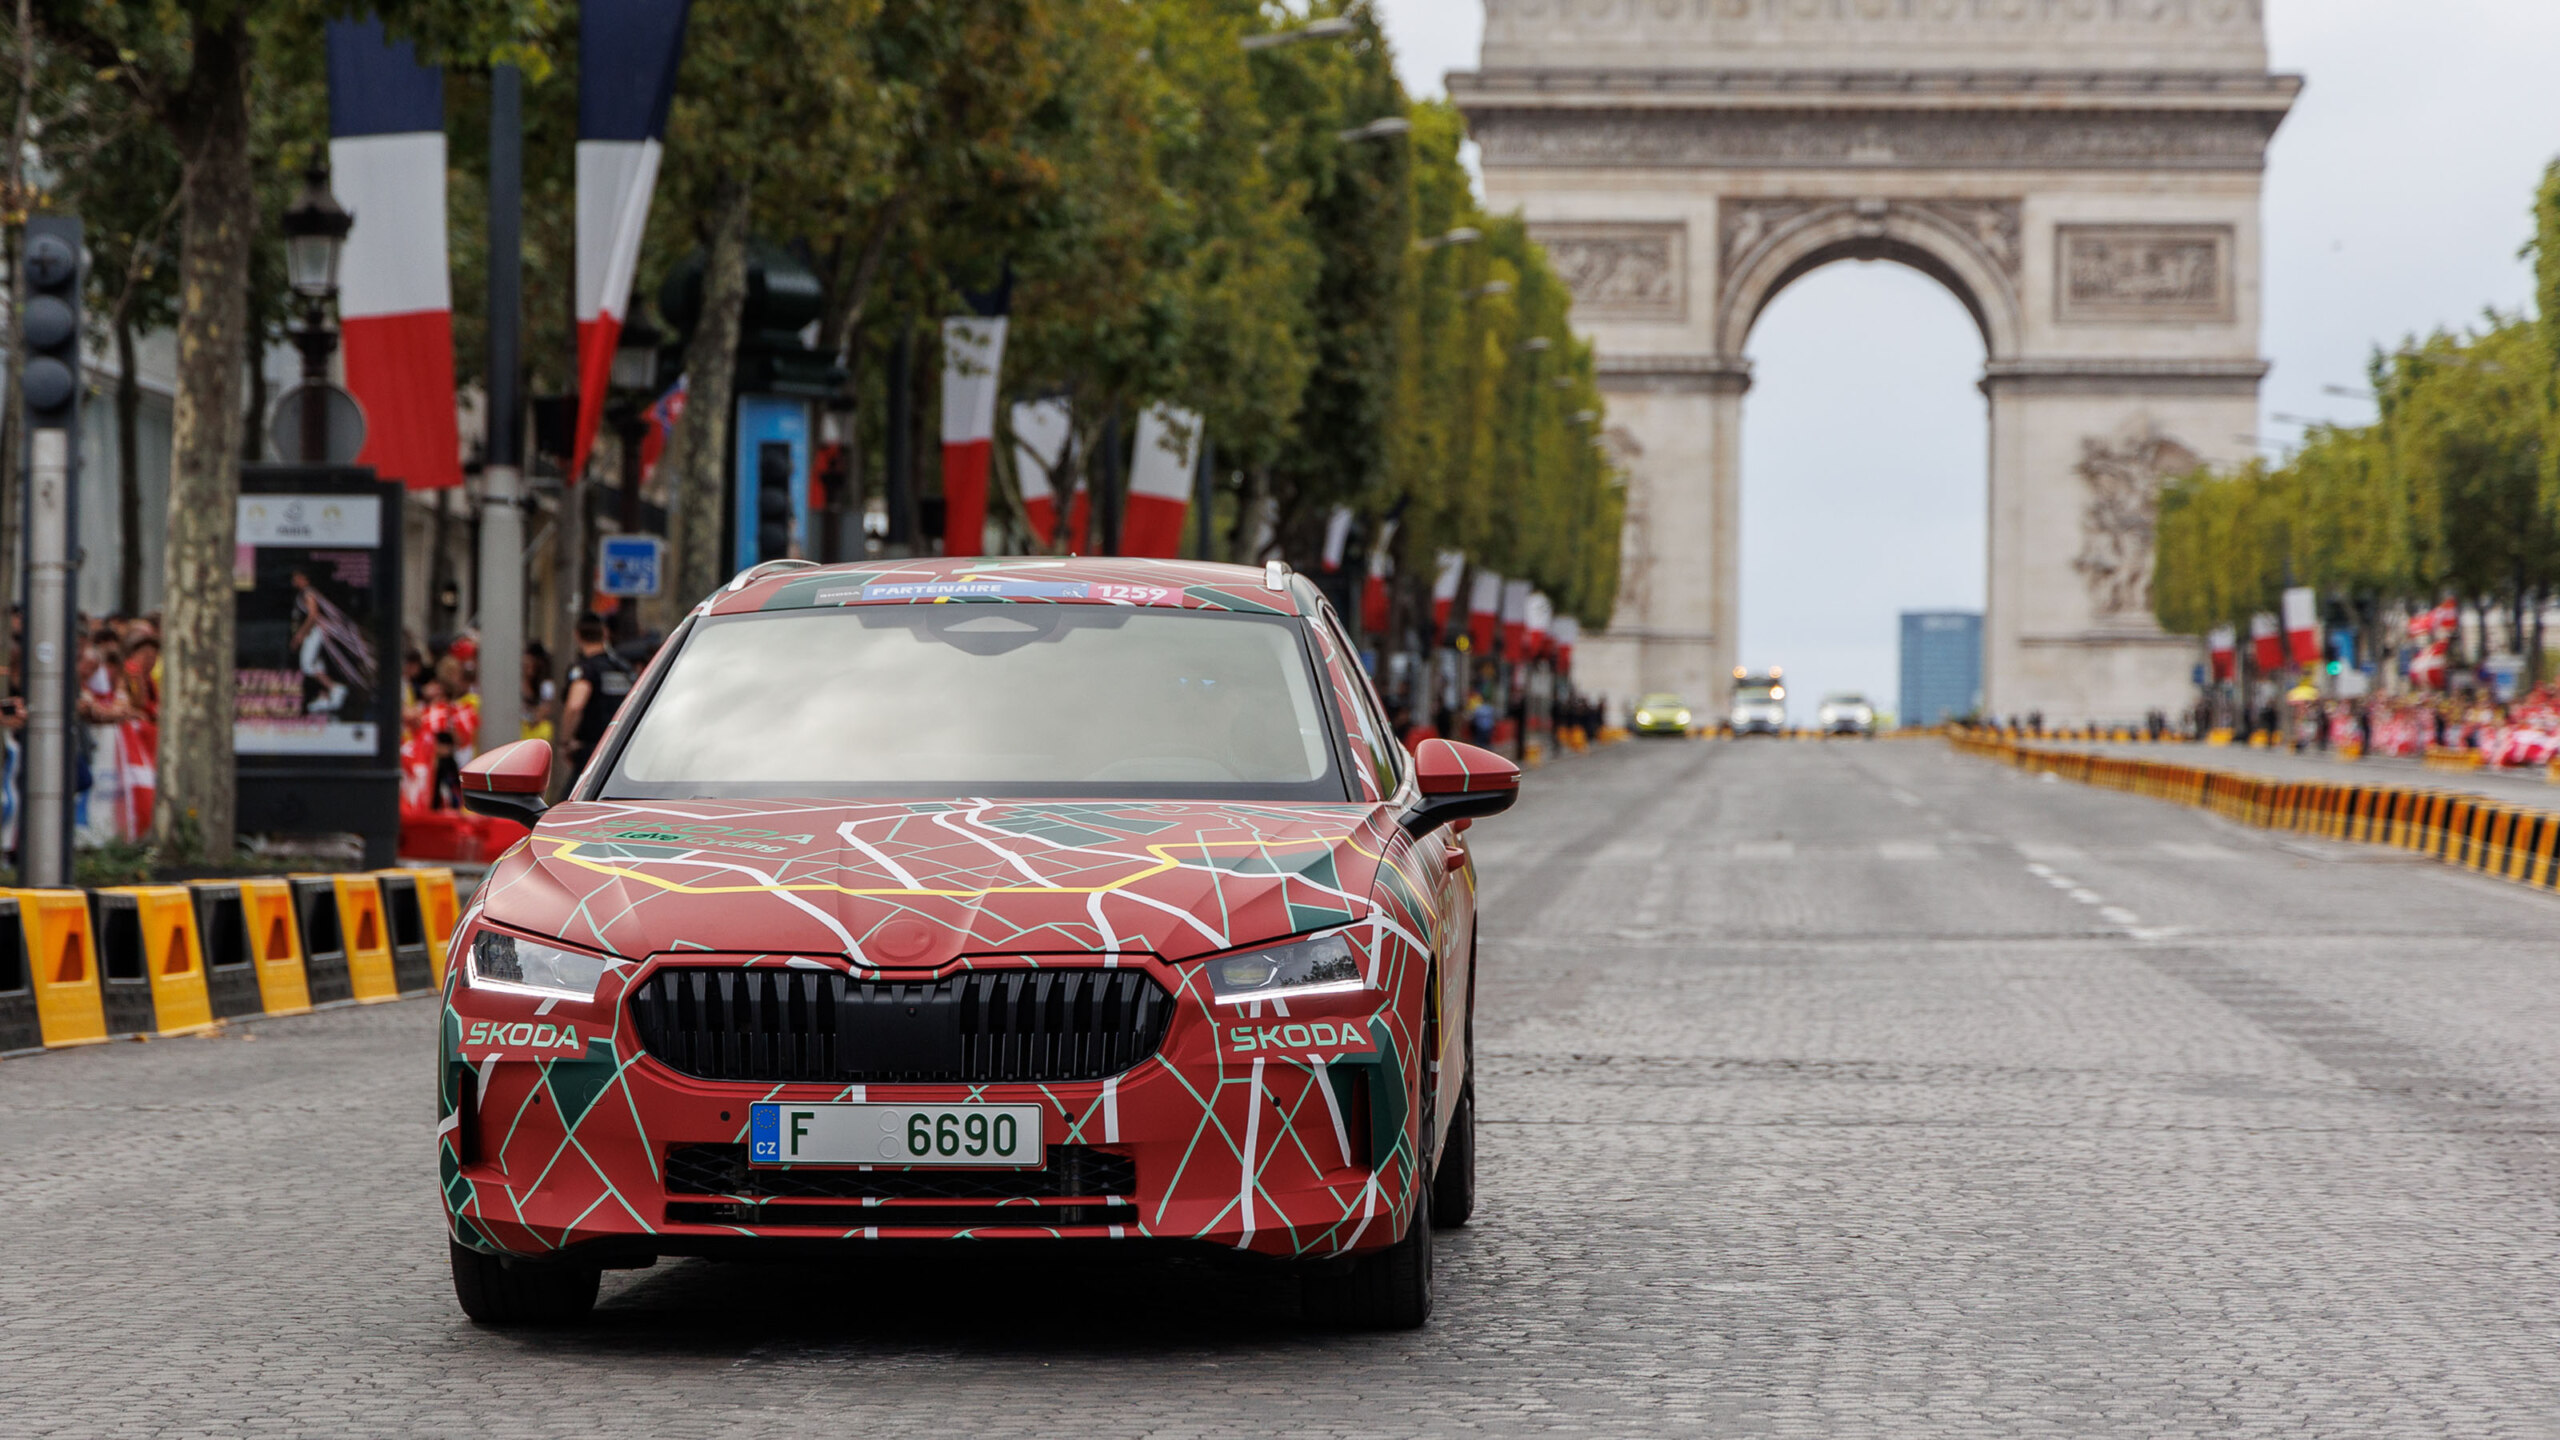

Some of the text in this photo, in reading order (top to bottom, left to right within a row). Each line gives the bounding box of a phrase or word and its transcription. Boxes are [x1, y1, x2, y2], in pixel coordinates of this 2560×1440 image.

[872, 584, 1002, 596] PARTENAIRE
[1097, 585, 1169, 601] 1259
[685, 836, 789, 853] Cycling
[790, 1111, 1017, 1157] F 6690
[756, 1141, 776, 1155] CZ
